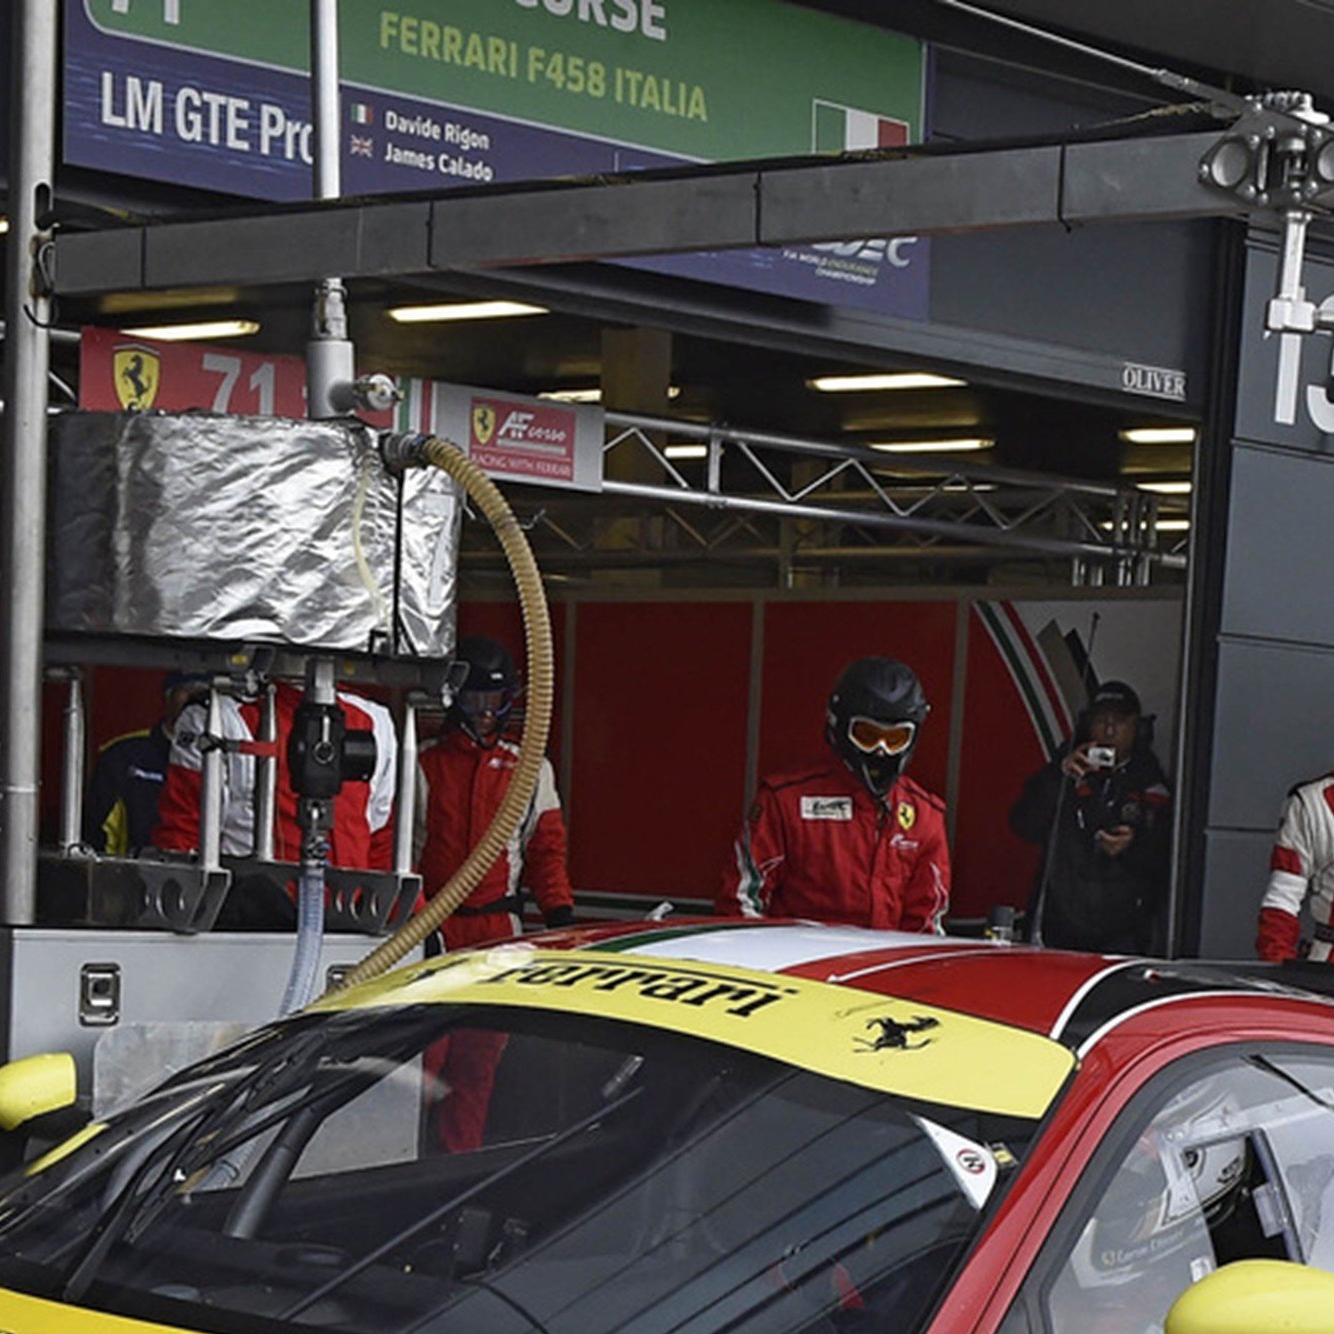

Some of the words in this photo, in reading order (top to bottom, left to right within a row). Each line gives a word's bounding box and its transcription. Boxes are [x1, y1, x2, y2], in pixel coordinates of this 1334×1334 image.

[380, 12, 517, 78] FERRARI
[527, 48, 605, 98] F458
[616, 67, 708, 122] ITALIA
[101, 71, 163, 134] LM
[175, 87, 249, 152] GTE
[384, 110, 441, 141] Davide
[444, 123, 490, 152] Rigon
[384, 142, 435, 172] James
[438, 155, 494, 183] Calado
[203, 353, 276, 413] 71
[1123, 367, 1185, 398] OLIVER
[479, 957, 799, 1018] Ferrari
